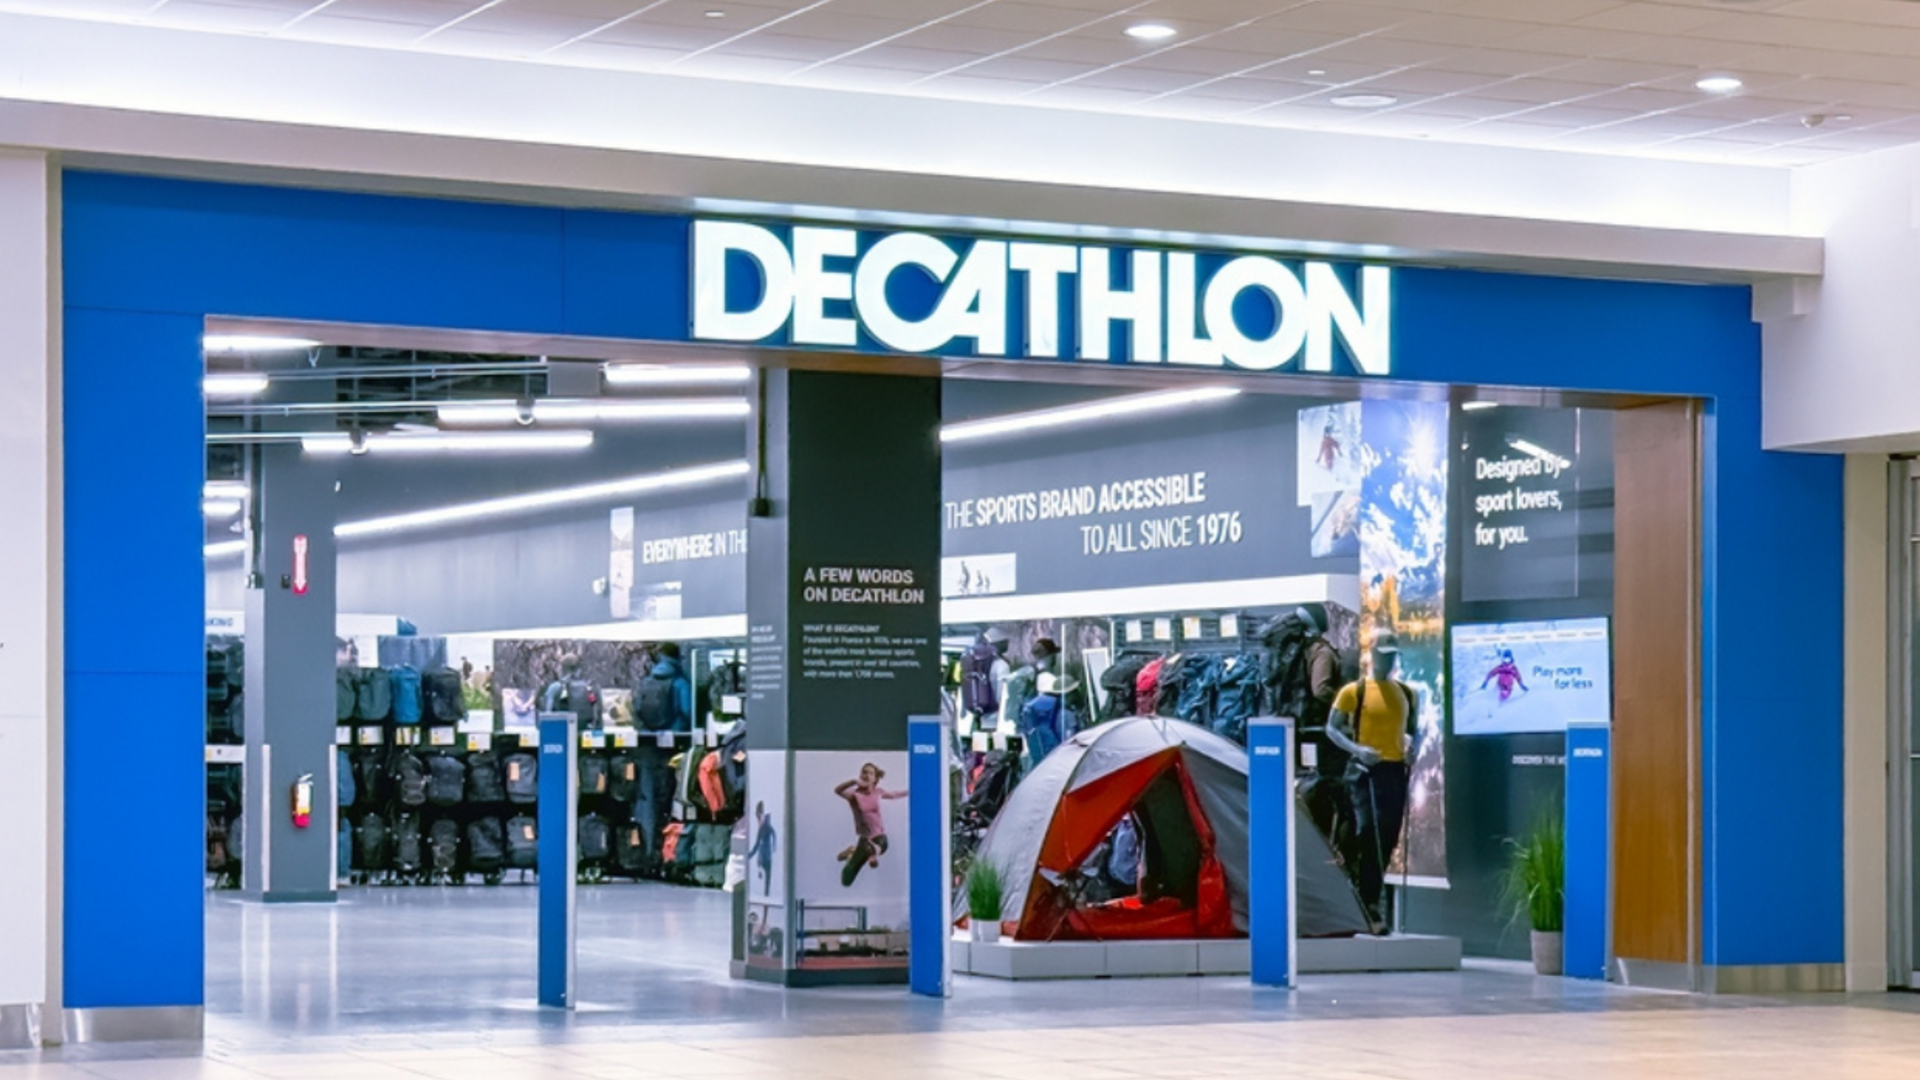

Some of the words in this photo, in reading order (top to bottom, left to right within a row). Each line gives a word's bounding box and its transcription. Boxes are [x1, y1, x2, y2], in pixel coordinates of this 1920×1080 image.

[692, 219, 1391, 375] DECATHLON
[1475, 454, 1541, 483] Designed
[944, 499, 974, 529] THE
[976, 491, 1037, 527] SPORTS
[1040, 485, 1095, 519] BRAND
[1098, 471, 1206, 514] ACCESSIBLE
[1475, 490, 1513, 518] sport
[1516, 486, 1563, 511] lovers,
[643, 533, 713, 564] EVERYWHERE
[715, 531, 726, 556] IN
[1080, 525, 1104, 555] TO
[1105, 521, 1138, 553] ALL
[1140, 515, 1193, 550] SINCE
[1196, 511, 1242, 545] 1976
[1475, 522, 1496, 545] for
[1499, 526, 1529, 550] you.
[803, 567, 816, 583] A
[819, 567, 853, 584] FEW
[856, 568, 914, 585] WORDS
[803, 587, 828, 602] ON
[831, 588, 925, 604] DECATHLON
[1533, 666, 1554, 679] Play
[1555, 679, 1569, 689] for
[1572, 679, 1593, 688] less
